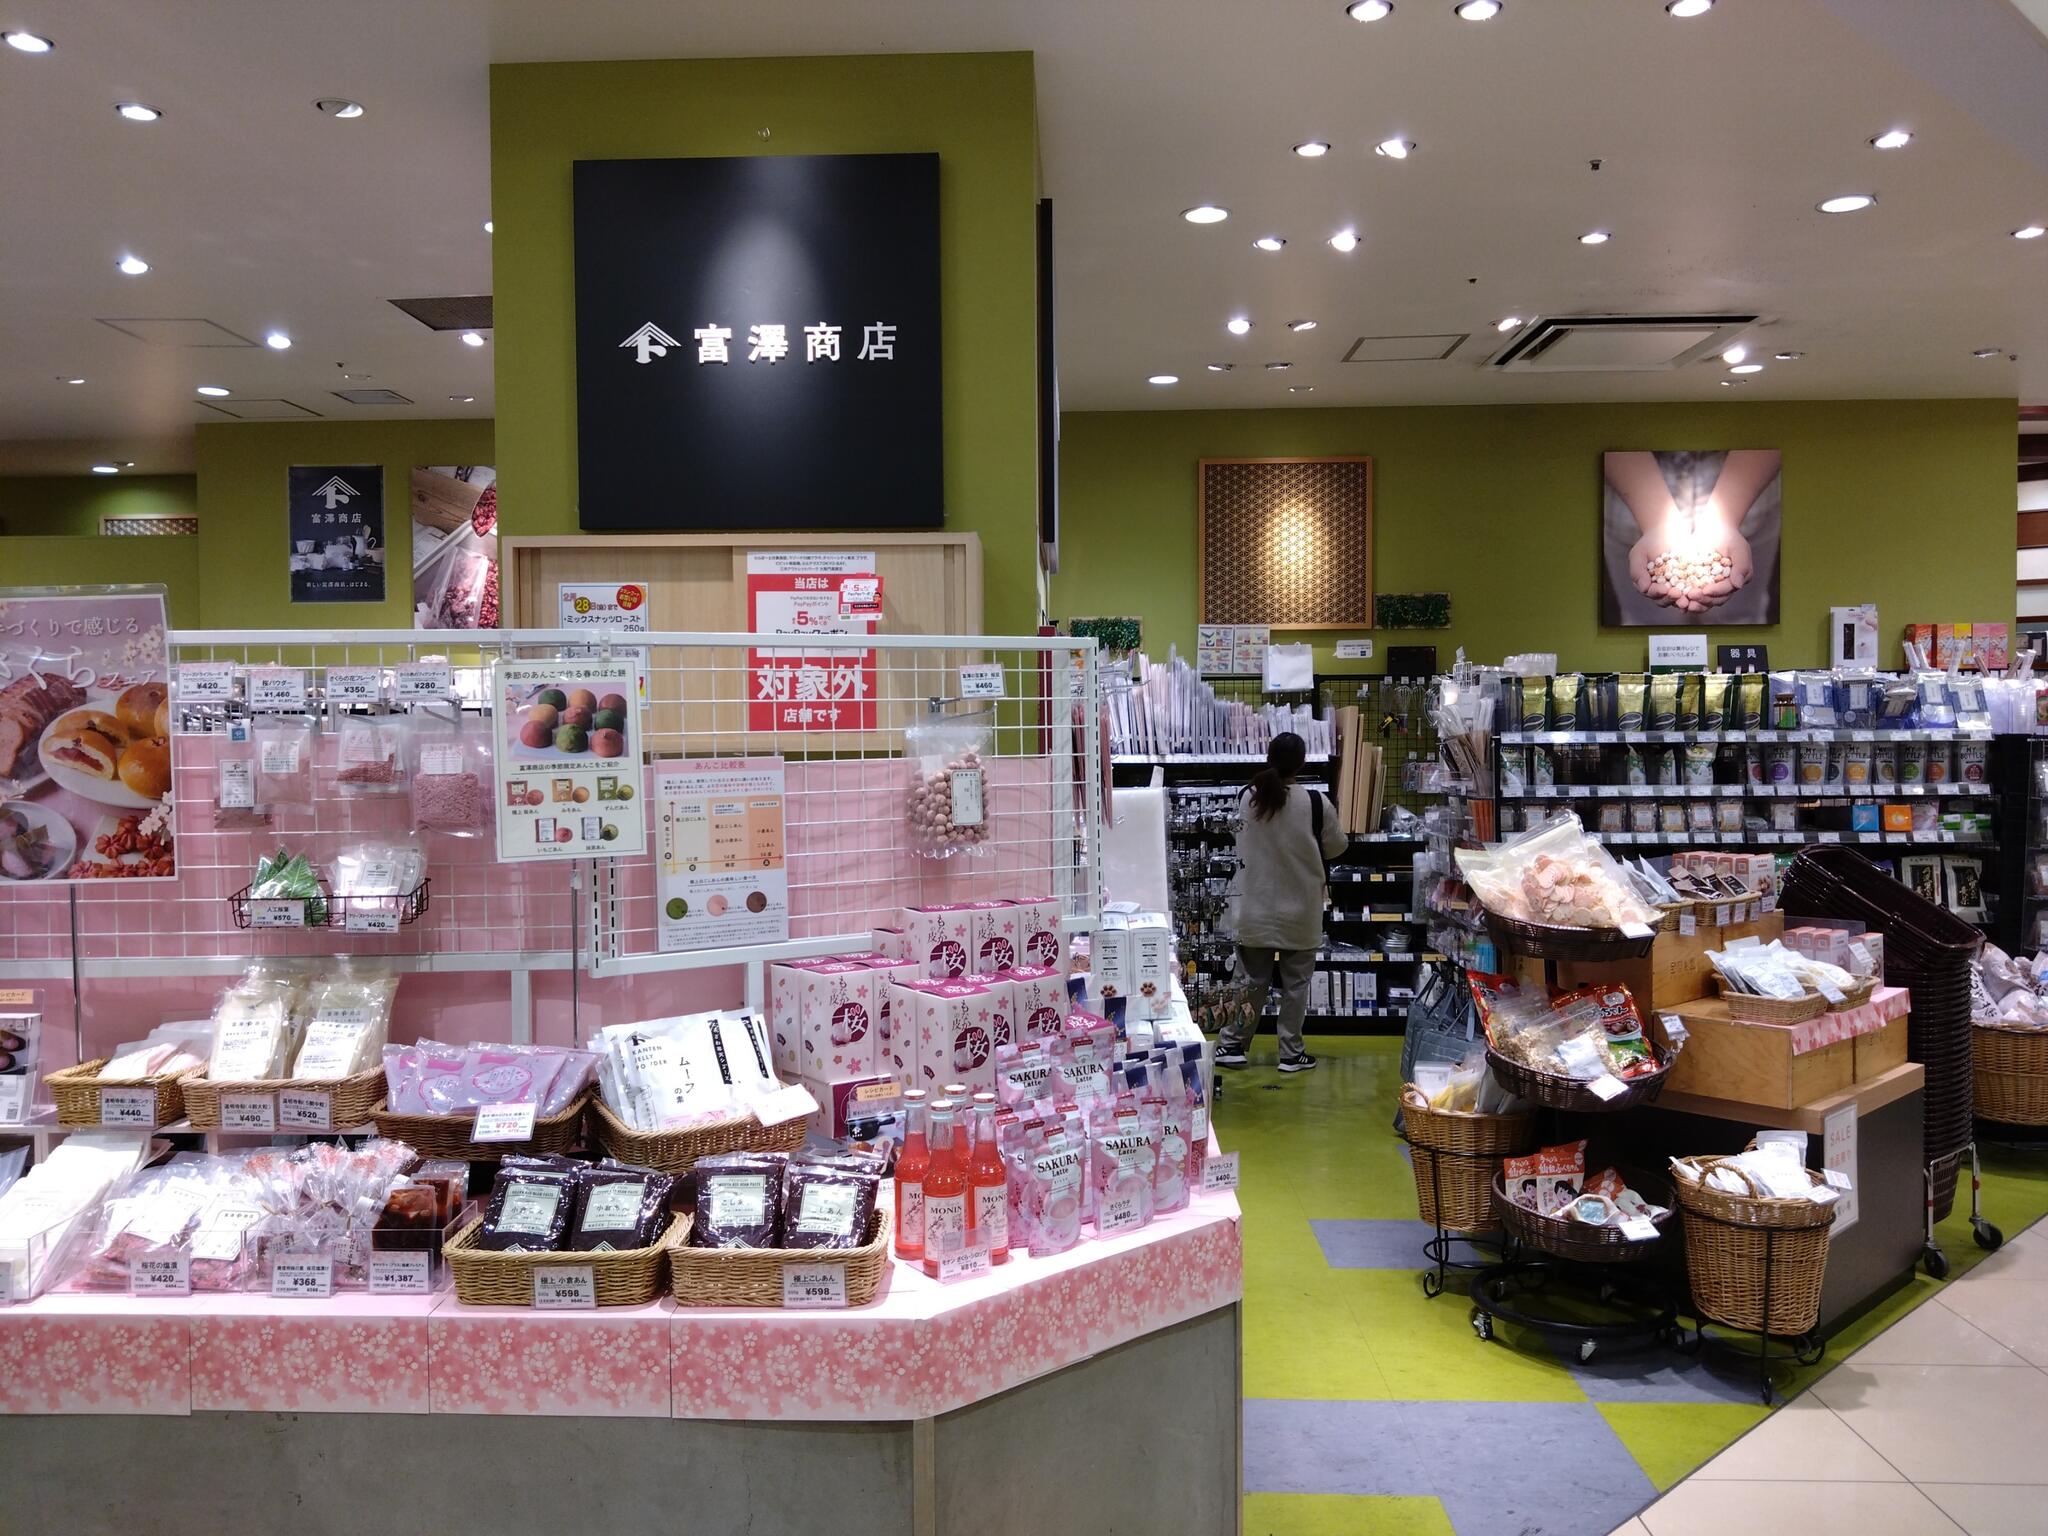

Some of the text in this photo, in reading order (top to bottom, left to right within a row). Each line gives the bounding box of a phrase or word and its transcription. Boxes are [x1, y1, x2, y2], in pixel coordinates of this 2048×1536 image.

[694, 322, 898, 364] 富澤商店
[311, 513, 362, 524] 富澤商店
[795, 577, 829, 590] 当店は
[0, 616, 139, 637] づくりで感じる
[197, 682, 218, 690] ¥420
[757, 663, 869, 701] 対象外
[632, 1046, 663, 1056] KANTEN
[634, 1054, 653, 1064] JELLY
[1063, 1063, 1105, 1079] SAKURA
[1023, 1079, 1042, 1088] Latte
[1075, 1075, 1093, 1084] Latte
[120, 1109, 141, 1117] ¥440
[297, 1110, 317, 1119] ¥520
[495, 1121, 518, 1129] ¥720
[1830, 1124, 1851, 1147] SALE
[1105, 1135, 1151, 1151] SAKURA
[1118, 1147, 1137, 1156] Latte
[1037, 1152, 1079, 1173] SAKURA
[1051, 1167, 1069, 1177] Latte
[1215, 1173, 1231, 1182] ¥400
[1114, 1210, 1131, 1221] ¥480
[151, 1274, 174, 1282] ¥420
[293, 1278, 316, 1286] ¥368
[384, 1274, 413, 1283] ¥1,387
[555, 1289, 580, 1297] ¥598
